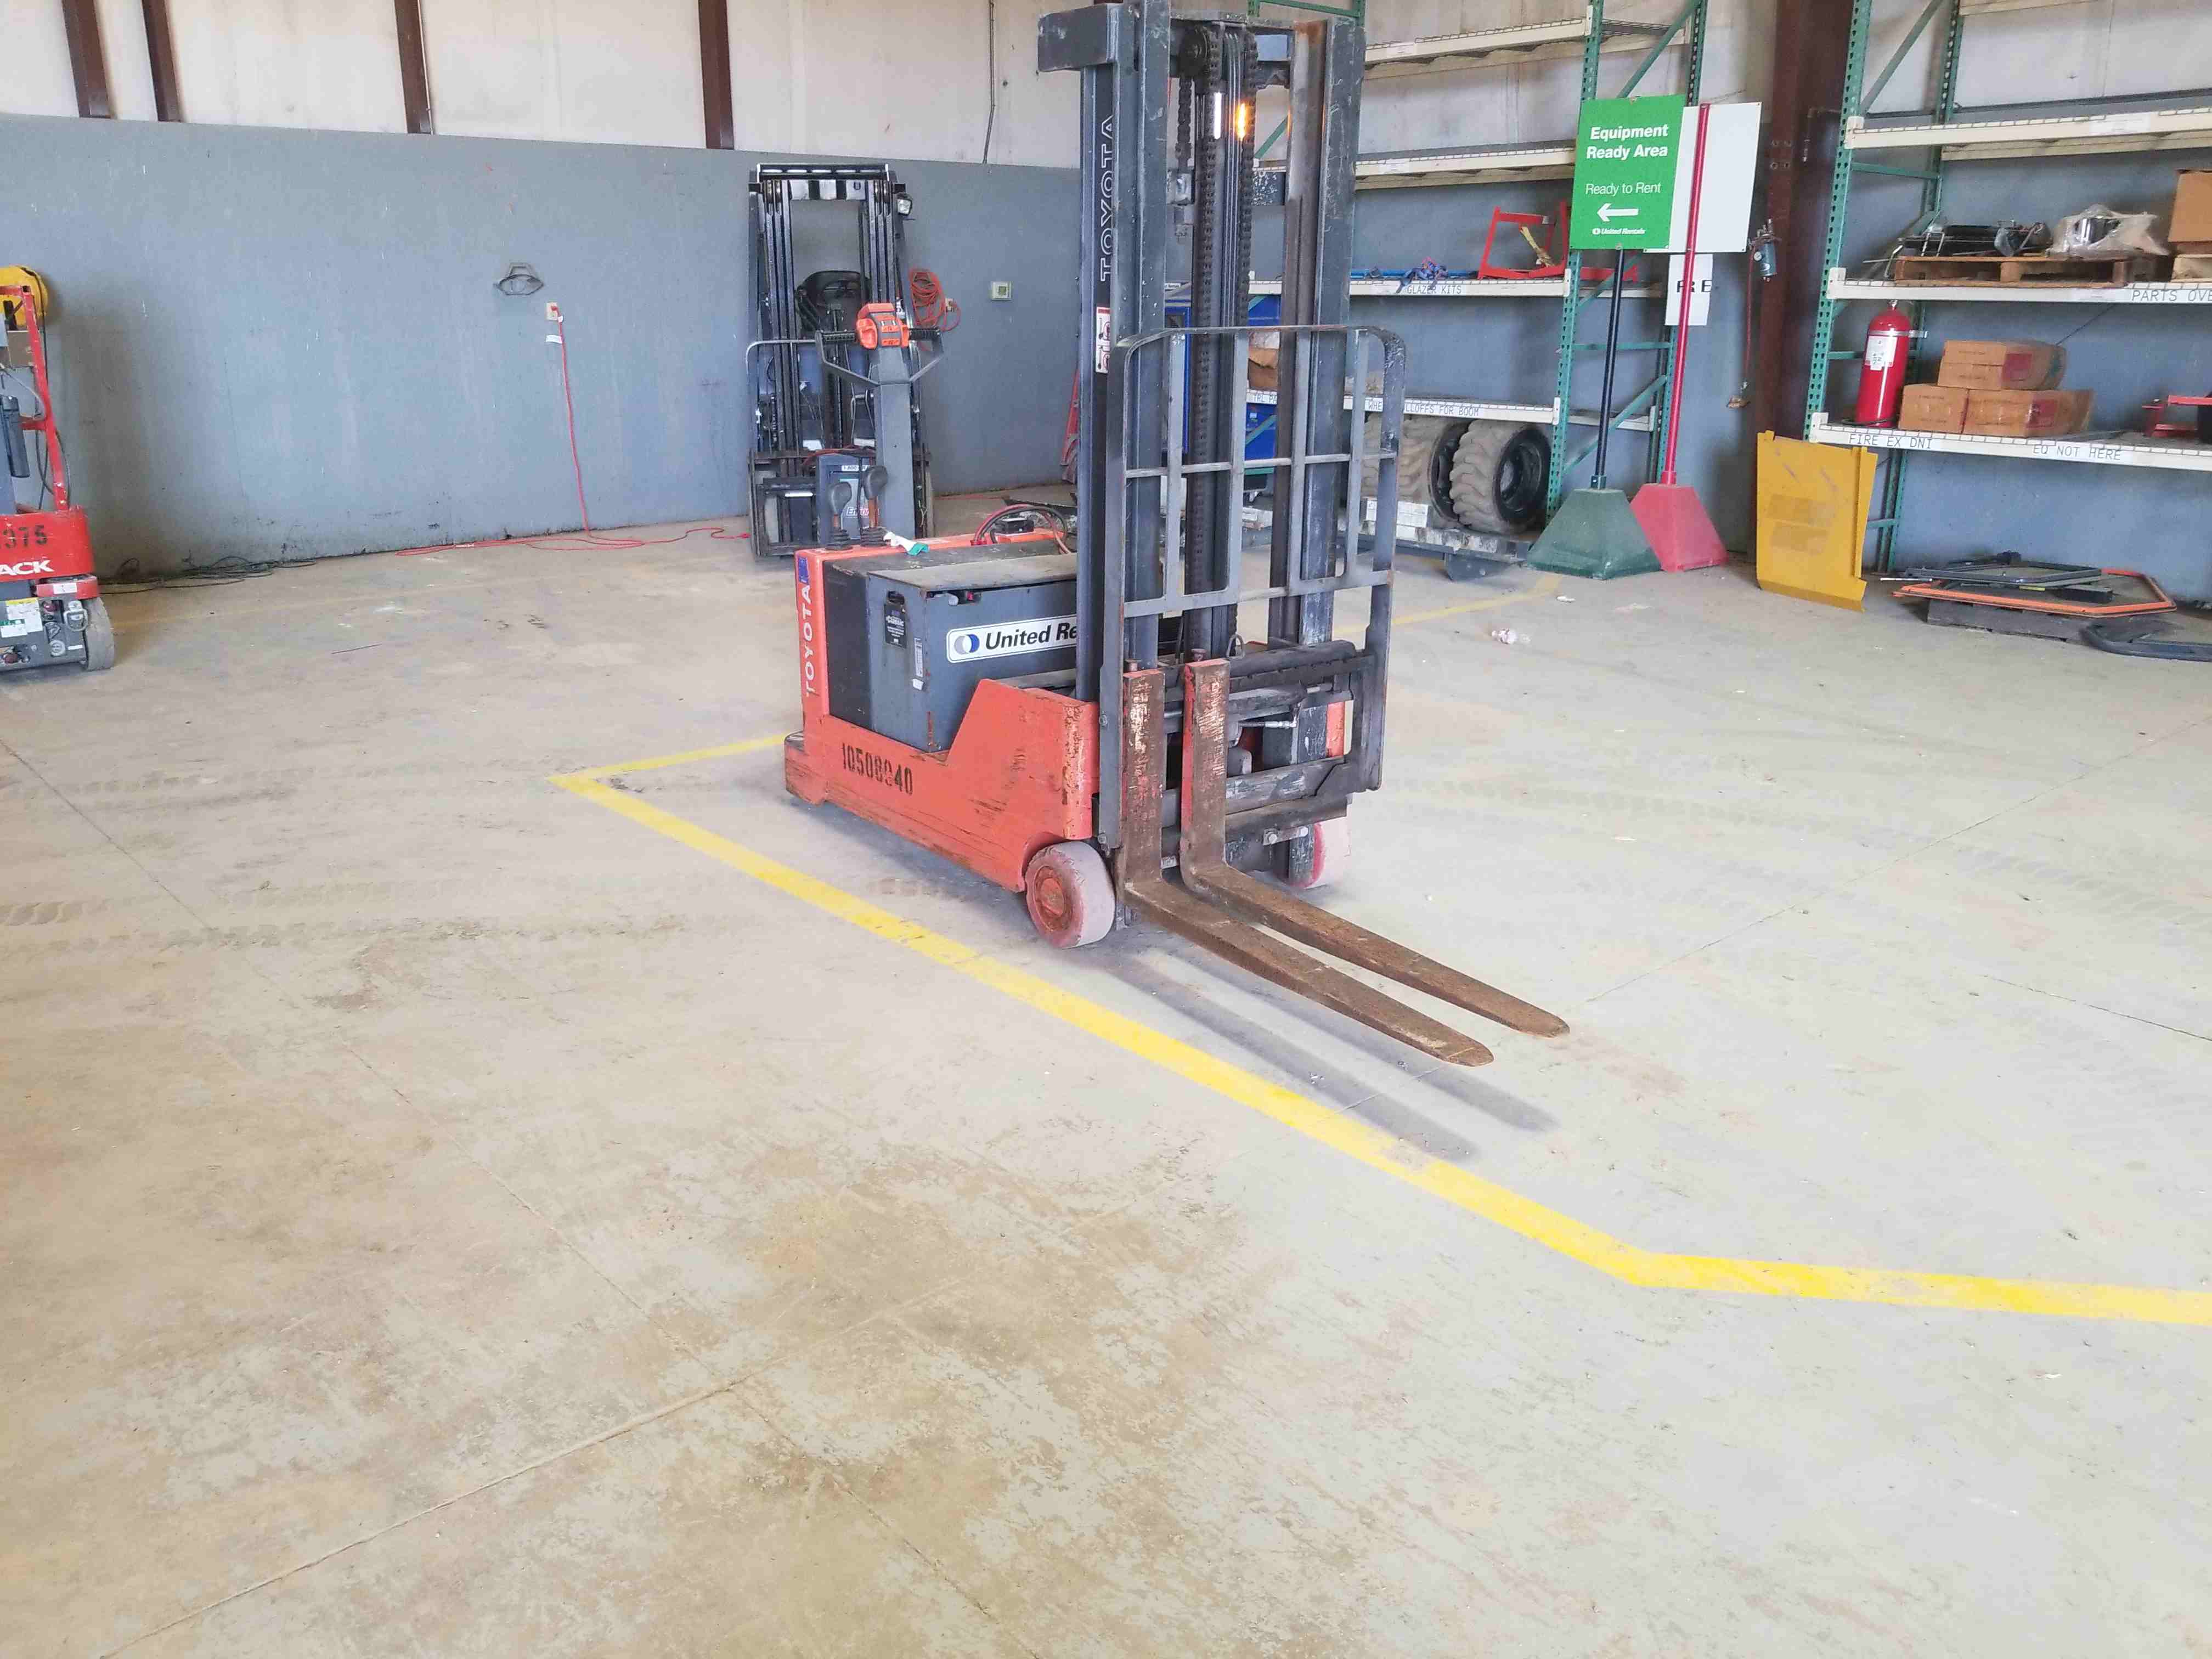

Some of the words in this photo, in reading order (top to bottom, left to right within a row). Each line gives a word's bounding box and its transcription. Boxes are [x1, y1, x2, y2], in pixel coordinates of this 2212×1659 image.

[1590, 123, 1669, 142] Equipment
[1586, 144, 1630, 161] Ready
[1633, 144, 1668, 157] Area
[1585, 182, 1620, 197] Ready
[1621, 183, 1633, 194] to
[1635, 182, 1661, 194] Rent
[1100, 114, 1114, 282] TOYOTA
[1441, 285, 1462, 295] KITS
[2132, 289, 2177, 302] PARTS
[1439, 404, 1454, 415] FOR
[1458, 405, 1480, 416] BOOM
[1849, 433, 1879, 445] FIRE
[1887, 436, 1901, 448] EX
[1910, 437, 1933, 449] DNI
[2056, 445, 2081, 457] NOT
[2089, 447, 2120, 460] HERE
[801, 585, 817, 698] TOYOTA
[985, 624, 1052, 650] United
